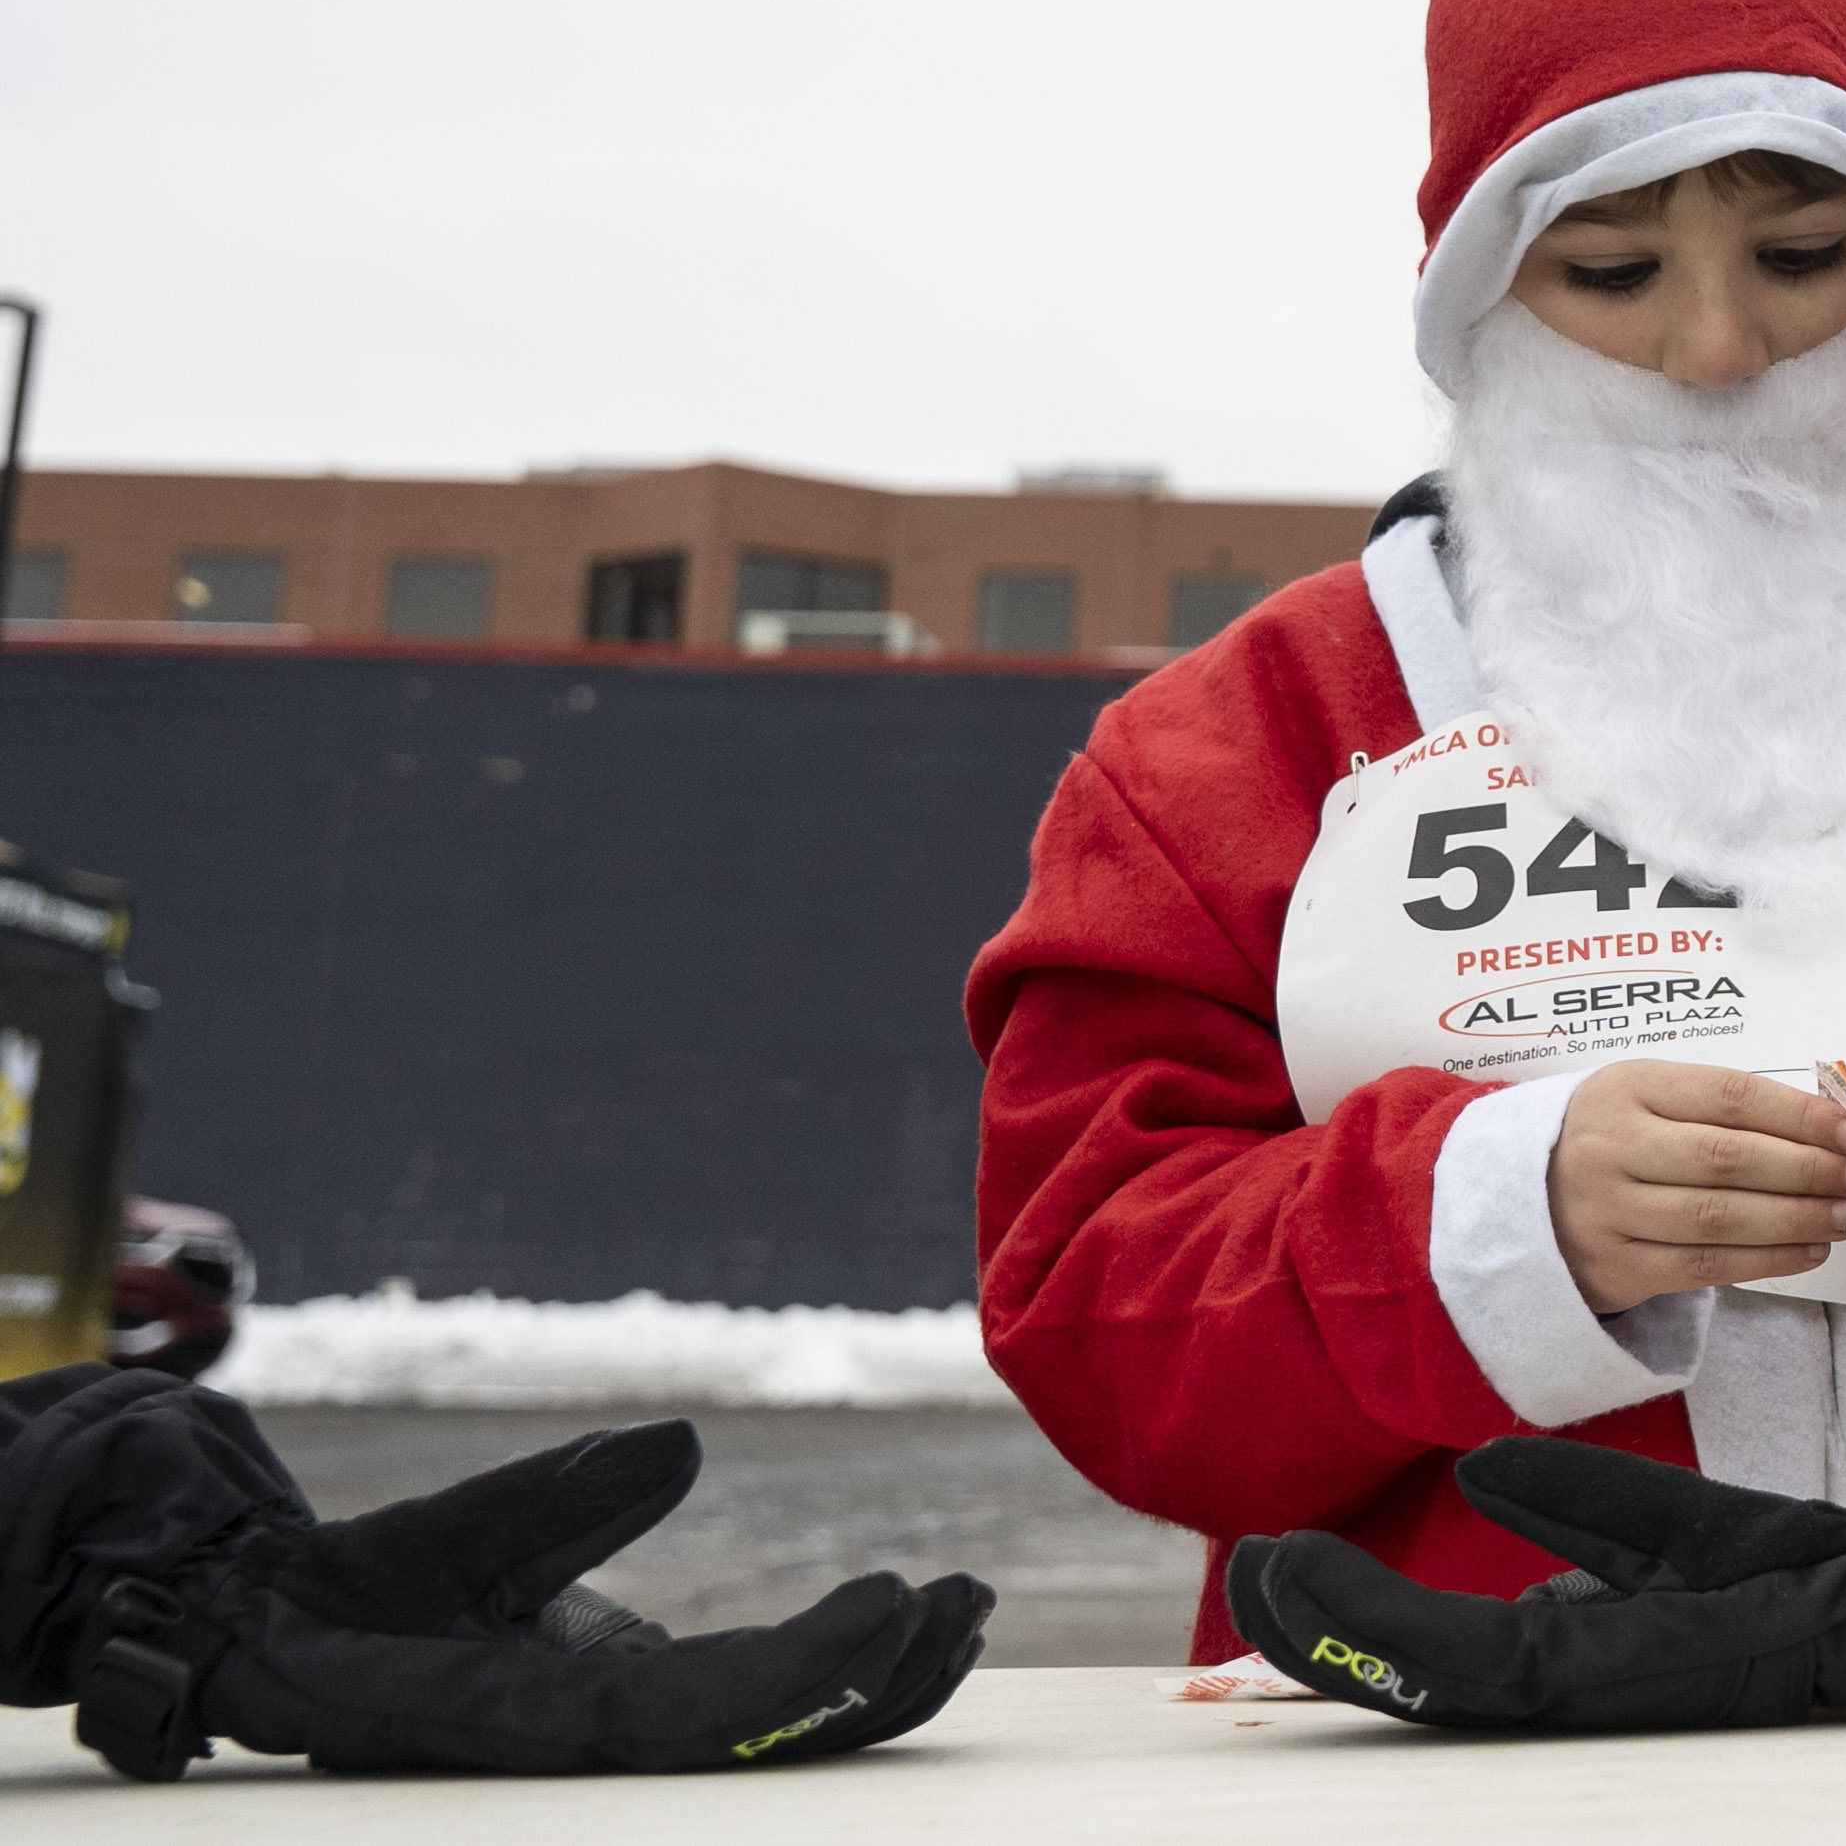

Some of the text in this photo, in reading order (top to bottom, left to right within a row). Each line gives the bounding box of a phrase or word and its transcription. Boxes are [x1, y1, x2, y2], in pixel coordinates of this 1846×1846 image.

[1393, 725, 1511, 776] YMCA O
[1457, 929, 1724, 977] PRESENTED BY:
[1464, 976, 1746, 1029] AL SERRA
[1547, 1004, 1742, 1038] AUTO PLAZA
[1443, 1022, 1744, 1073] One destination. So many more choices!
